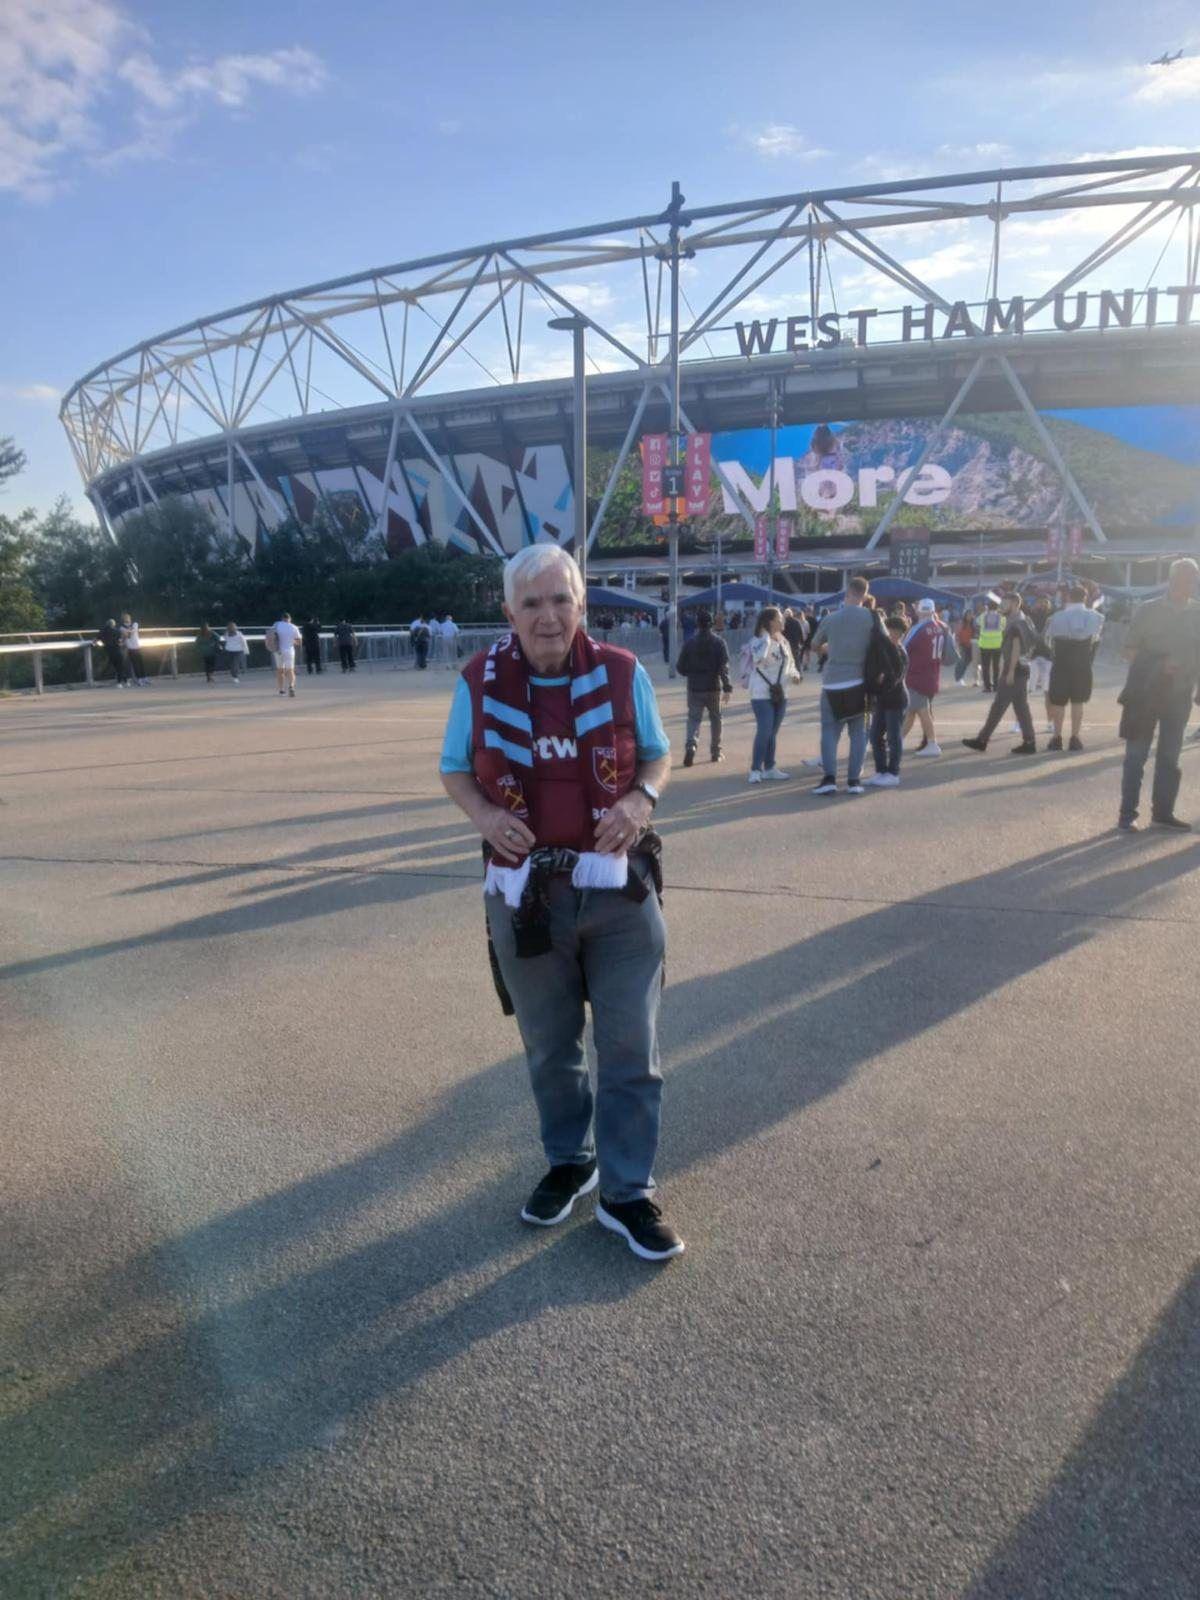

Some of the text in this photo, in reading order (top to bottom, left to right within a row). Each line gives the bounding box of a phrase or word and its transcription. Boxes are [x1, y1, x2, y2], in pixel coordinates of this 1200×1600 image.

[735, 286, 1200, 356] WEST HAM UNIT
[669, 476, 678, 495] 1
[693, 437, 703, 496] PLAY
[719, 457, 952, 514] More
[533, 736, 578, 759] tw
